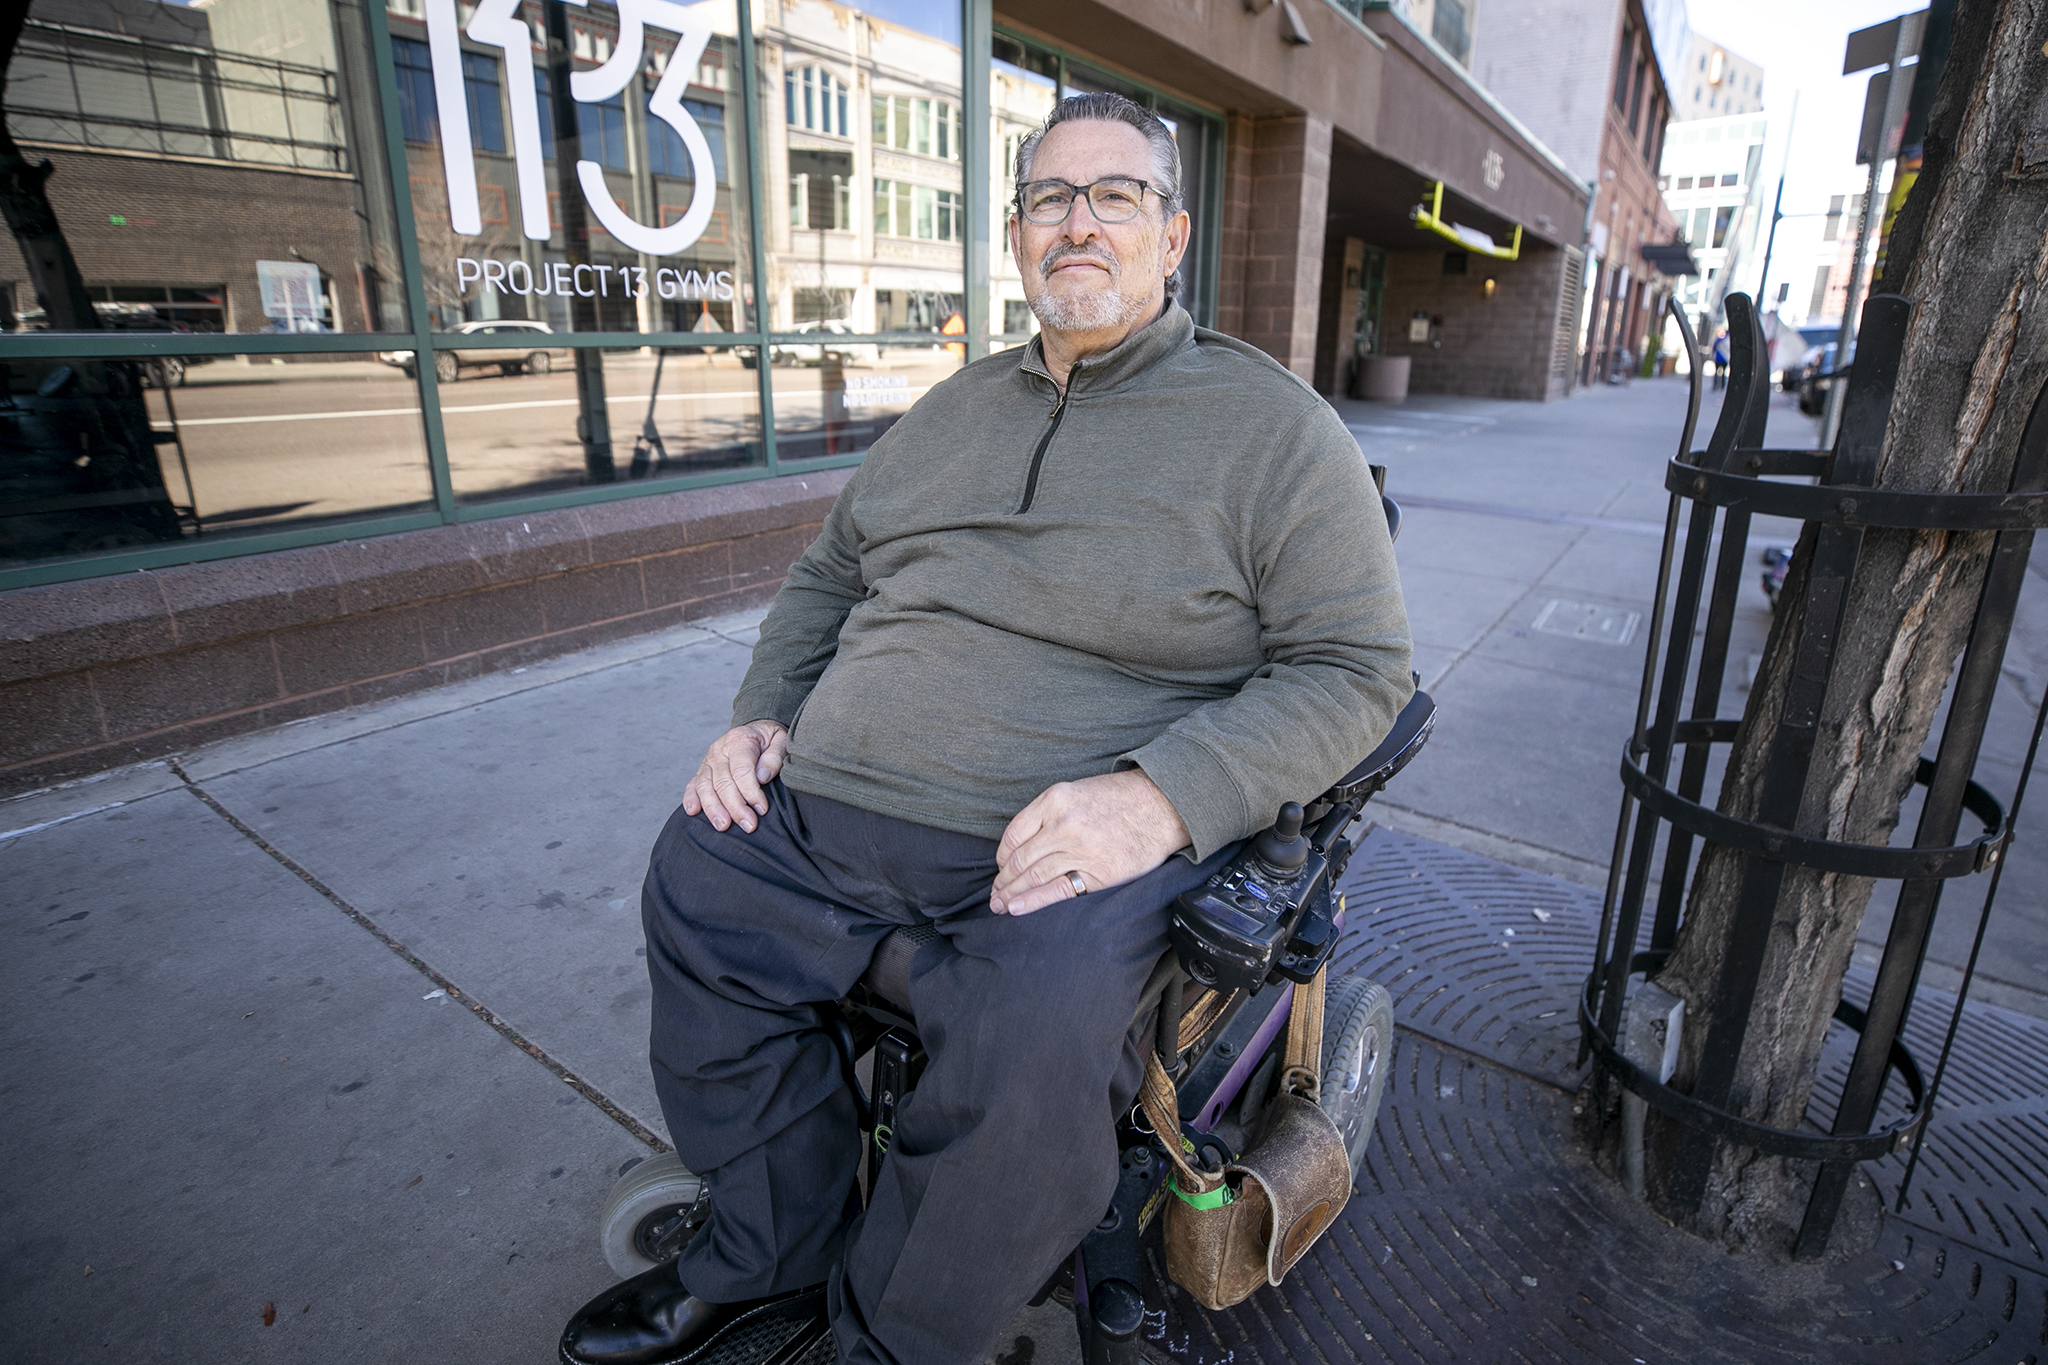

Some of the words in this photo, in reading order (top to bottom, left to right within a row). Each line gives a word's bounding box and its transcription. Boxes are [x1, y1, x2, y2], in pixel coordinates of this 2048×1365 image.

[456, 257, 613, 298] PROJECT
[618, 265, 650, 299] 13
[656, 267, 734, 301] GYMS
[845, 377, 861, 390] NO
[862, 375, 909, 389] SMOKING
[842, 393, 859, 408] NO
[860, 391, 912, 407] LOITERING
